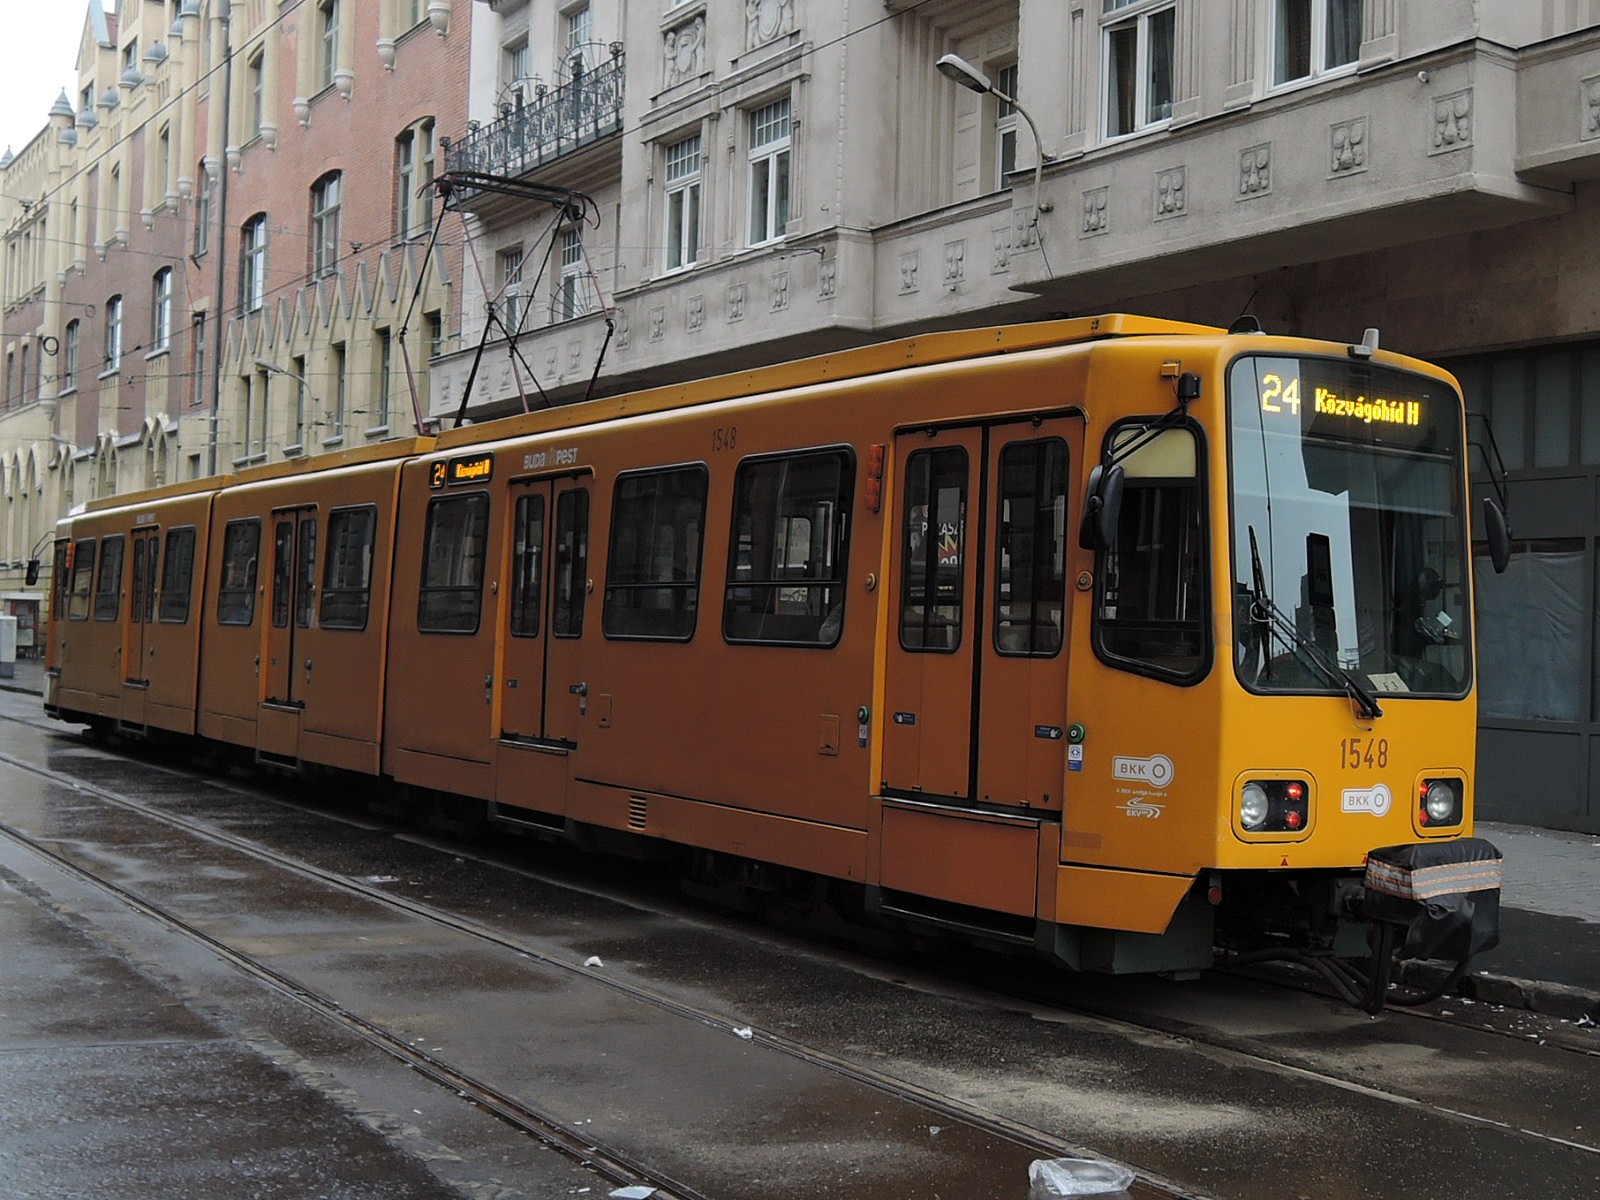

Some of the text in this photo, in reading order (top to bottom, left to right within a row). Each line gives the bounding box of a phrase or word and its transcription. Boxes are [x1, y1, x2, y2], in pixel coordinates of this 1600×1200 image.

[1262, 374, 1300, 415] 24
[1406, 401, 1419, 425] H
[712, 426, 737, 452] 1548
[1341, 738, 1389, 769] 1548
[1120, 763, 1146, 775] BKK
[1349, 792, 1370, 806] BKK
